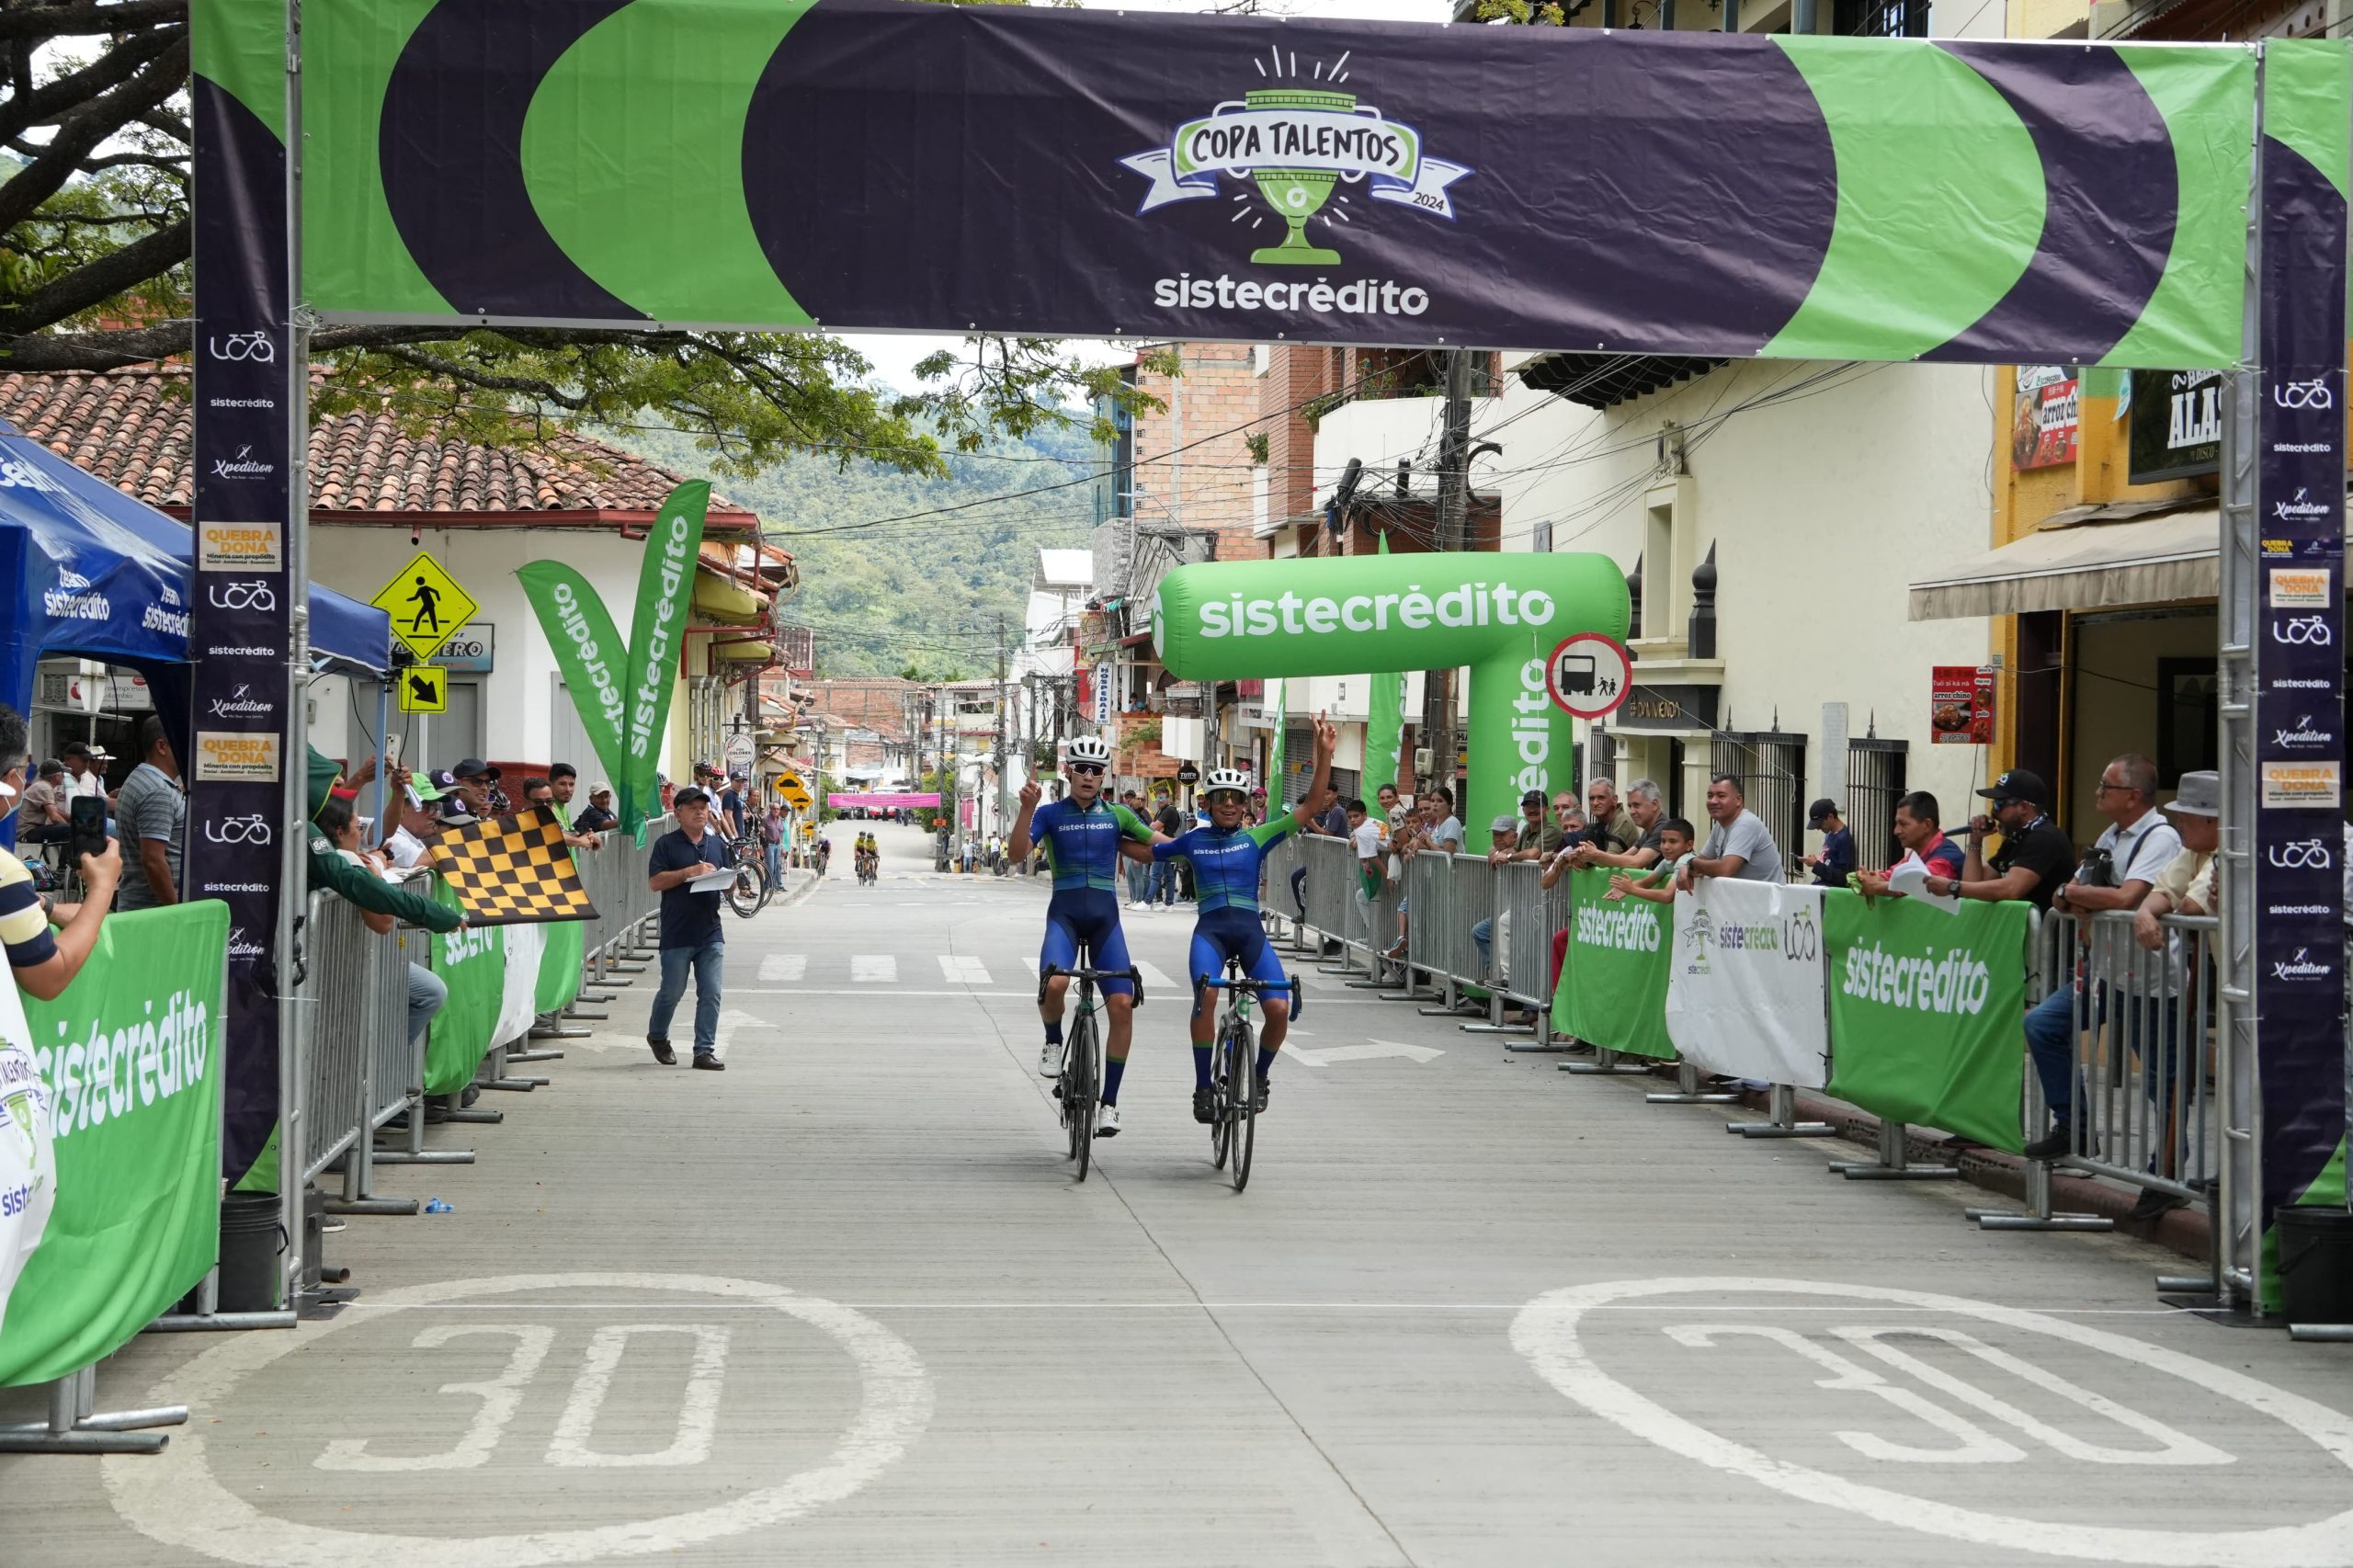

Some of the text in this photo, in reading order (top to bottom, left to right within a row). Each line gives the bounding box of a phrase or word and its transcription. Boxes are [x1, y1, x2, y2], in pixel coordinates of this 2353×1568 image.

[1192, 121, 1400, 167] COPA TALENTOS
[1412, 191, 1446, 212] 2024
[1154, 272, 1429, 316] sistecrédito
[210, 397, 274, 408] sistecrédito
[2042, 403, 2065, 425] arroz
[2196, 445, 2215, 460] DISCO
[2273, 442, 2331, 452] sistecrédito
[210, 459, 274, 479] Xpedition
[2272, 502, 2330, 520] Xpedition
[205, 528, 275, 544] QUEBRA
[220, 541, 269, 553] DONA
[59, 564, 91, 588] team
[2275, 575, 2325, 585] QUEBRA
[160, 581, 181, 607] team
[2284, 585, 2319, 594] DONA
[44, 588, 110, 621] sistecrédito
[1199, 581, 1556, 638] sistecrédito
[630, 516, 688, 760] sistecrédito
[209, 646, 275, 656] sistecrédito
[2272, 679, 2331, 688] sistecrédito
[1098, 667, 1108, 720] HOSPEDAJE
[208, 699, 274, 718] Xpedition
[204, 739, 272, 753] QUEBRA
[2271, 730, 2332, 748] Xpedition
[217, 752, 266, 764] DONA
[2268, 768, 2333, 780] QUEBRA
[2281, 781, 2327, 791] DONA
[204, 882, 270, 892] sistecrédito
[2269, 904, 2330, 915] sistecrédito
[1577, 898, 1661, 952] sistecrédito
[1844, 936, 1990, 1017] sistecrédito
[2270, 961, 2331, 981] Xpedition
[312, 1324, 732, 1471] 30
[1660, 1325, 2239, 1466] 30
